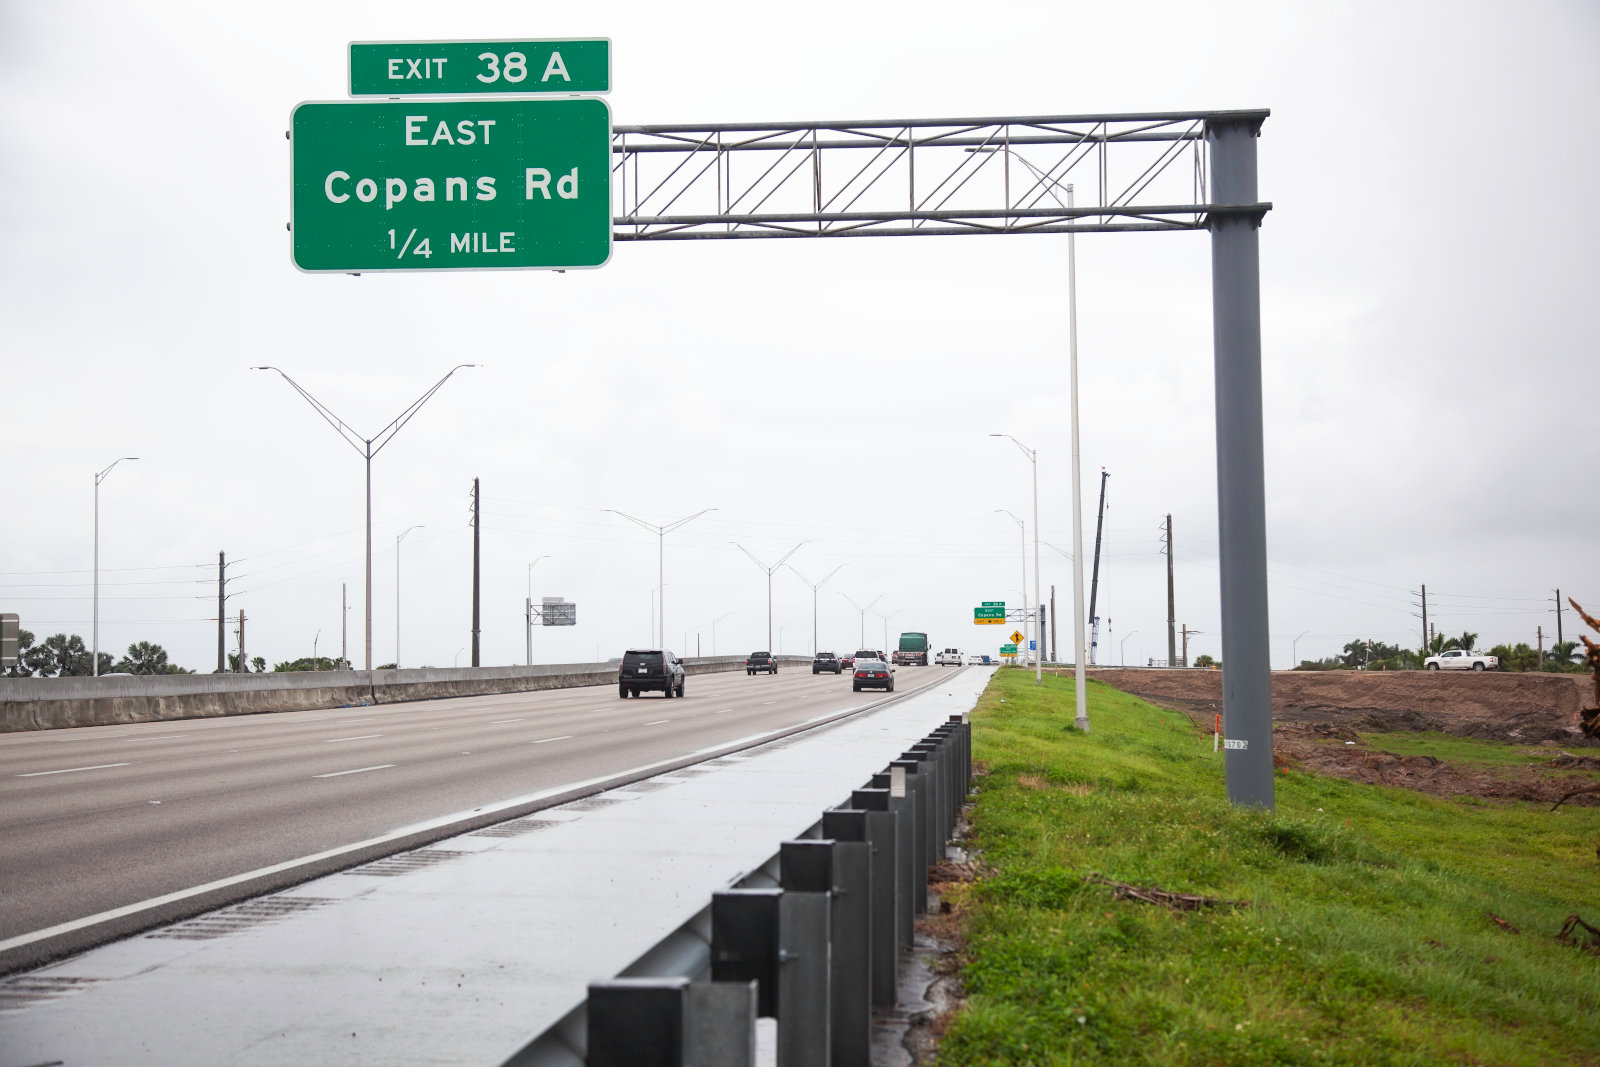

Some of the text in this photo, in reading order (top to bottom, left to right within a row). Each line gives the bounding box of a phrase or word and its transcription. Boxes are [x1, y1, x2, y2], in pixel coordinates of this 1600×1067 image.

[388, 51, 571, 84] EXIT 38 A
[405, 115, 496, 146] EAST
[324, 166, 578, 211] Copans Rd
[388, 228, 516, 259] 1/4 MILE
